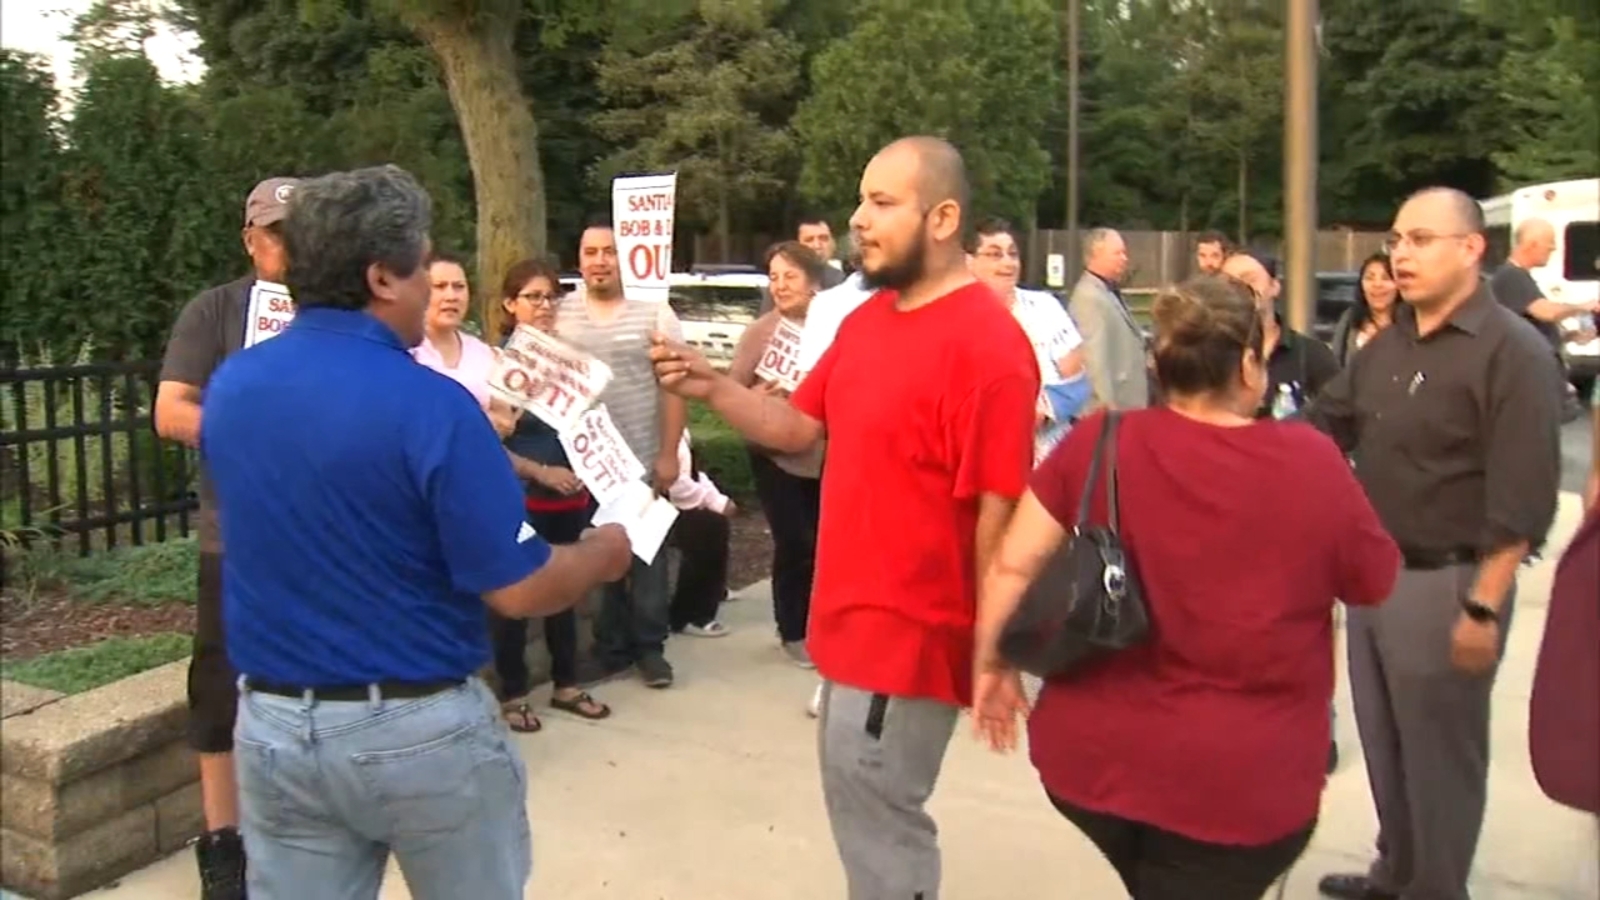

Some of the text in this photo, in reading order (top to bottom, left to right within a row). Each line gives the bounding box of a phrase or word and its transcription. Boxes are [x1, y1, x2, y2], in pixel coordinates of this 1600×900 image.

[620, 219, 651, 237] BOB
[654, 219, 664, 236] &
[503, 368, 576, 417] OUT!
[573, 433, 617, 493] OUT!
